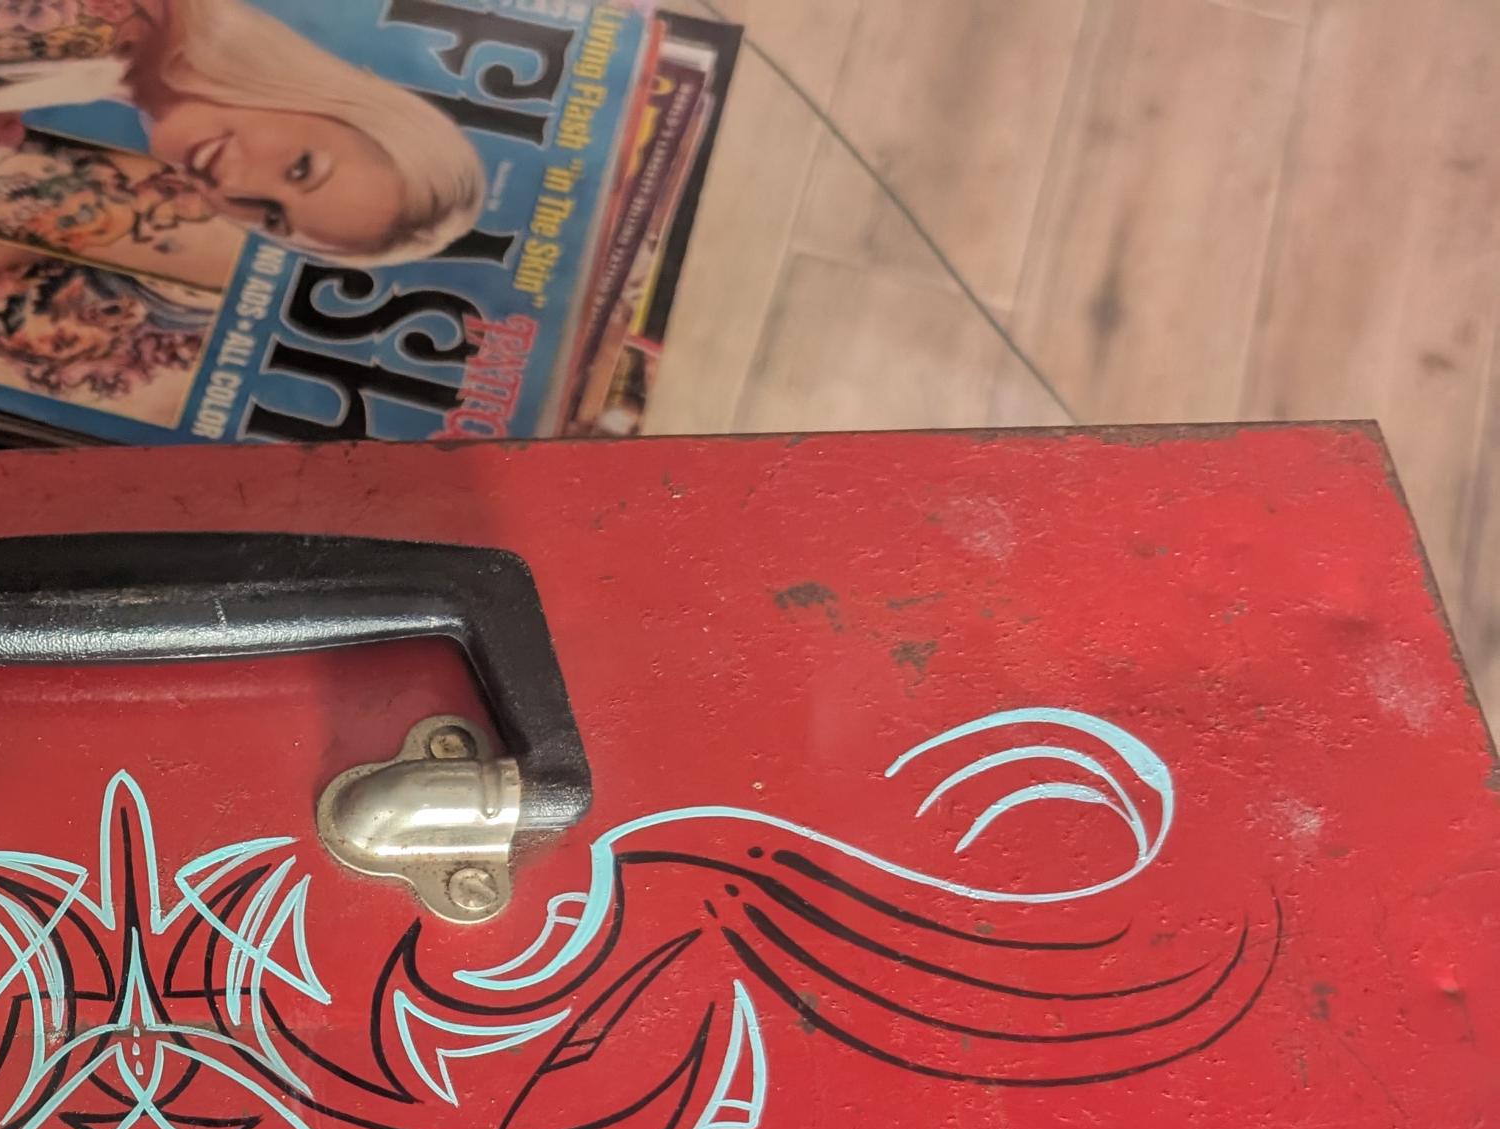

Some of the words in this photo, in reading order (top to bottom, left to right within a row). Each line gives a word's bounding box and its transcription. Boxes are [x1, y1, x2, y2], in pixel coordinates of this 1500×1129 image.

[573, 4, 628, 80] Living
[556, 82, 608, 150] Flash
[530, 195, 575, 238] The
[252, 243, 287, 276] NO
[512, 239, 562, 309] Skin"
[235, 275, 277, 320] ADS
[216, 329, 257, 368] ALL
[190, 370, 243, 440] COLOR
